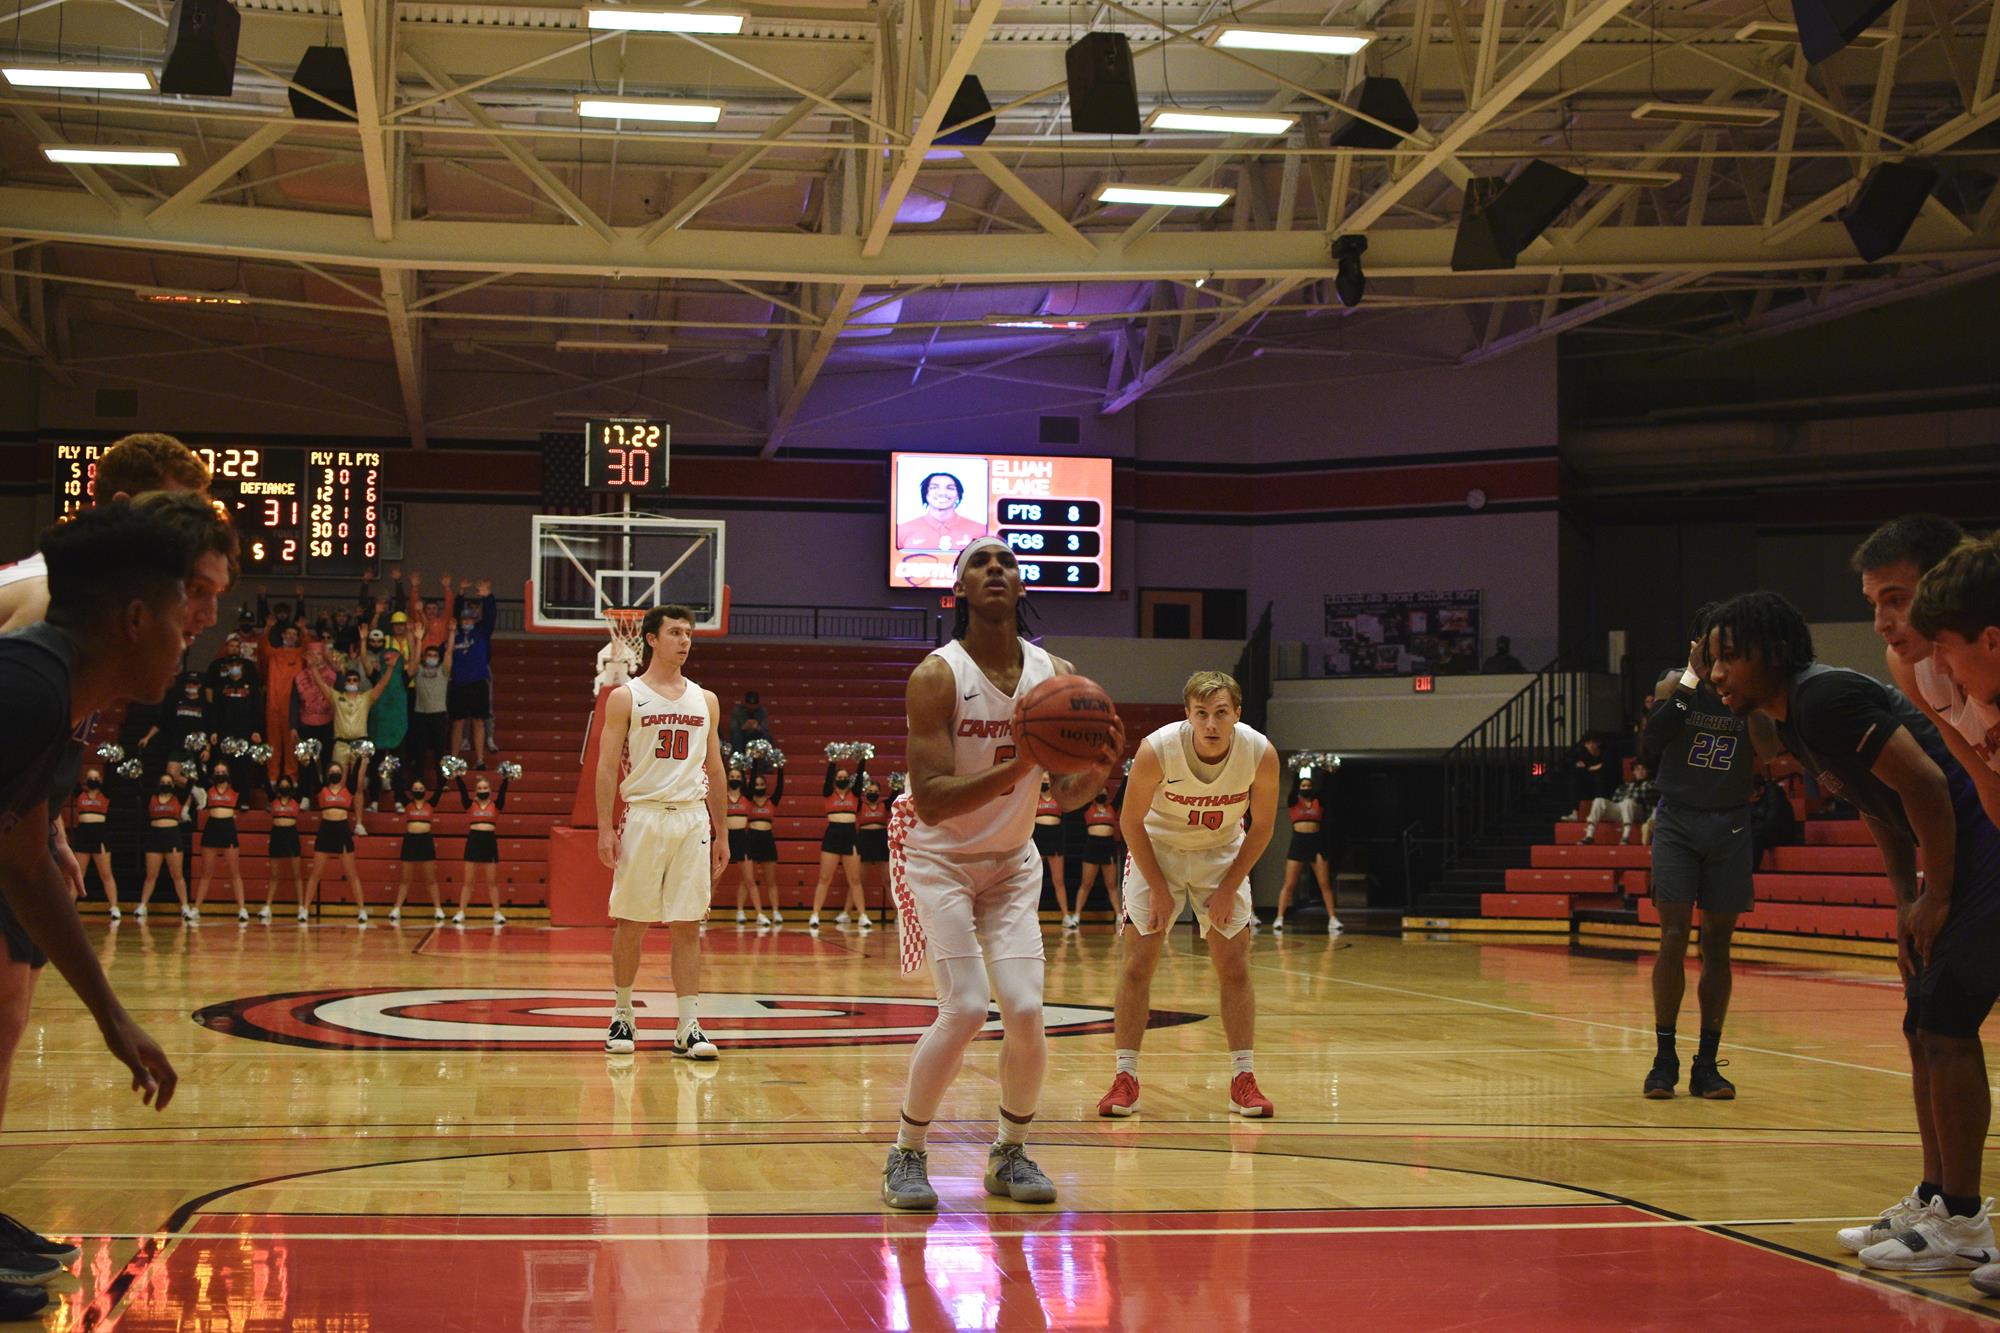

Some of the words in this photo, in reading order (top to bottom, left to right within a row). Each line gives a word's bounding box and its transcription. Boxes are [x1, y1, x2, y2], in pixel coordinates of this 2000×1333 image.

[58, 445, 81, 459] PLY
[86, 446, 101, 460] FL
[311, 451, 333, 465] PLY
[338, 452, 353, 466] FL
[356, 452, 380, 467] PTS
[194, 449, 259, 477] 7:22
[608, 448, 650, 486] 30
[991, 459, 1053, 478] ELIJAH
[324, 468, 334, 485] 3
[339, 469, 350, 485] 0
[366, 469, 377, 485] 2
[64, 480, 81, 496] 10
[240, 482, 296, 495] DEFIANCE
[317, 485, 334, 502] 12
[366, 487, 377, 503] 6
[991, 477, 1050, 496] BLAKE
[264, 499, 298, 526] 31
[311, 504, 333, 521] 22
[366, 505, 376, 521] 6
[1007, 503, 1042, 521] PTS
[1067, 505, 1080, 522] 8
[312, 521, 333, 538] 30
[338, 522, 348, 538] 0
[365, 522, 376, 539] 0
[282, 539, 296, 561] 2
[365, 541, 375, 557] 0
[1007, 533, 1044, 550] FGS
[1067, 534, 1080, 551] 3
[1018, 564, 1041, 581] TS
[1067, 565, 1079, 582] 2
[641, 713, 705, 728] CARTHAGE
[957, 719, 1013, 739] CARTH
[655, 729, 689, 760] 30
[1688, 732, 1737, 770] 22
[1164, 791, 1249, 807] CARTHAGE
[1187, 810, 1224, 831] 10
